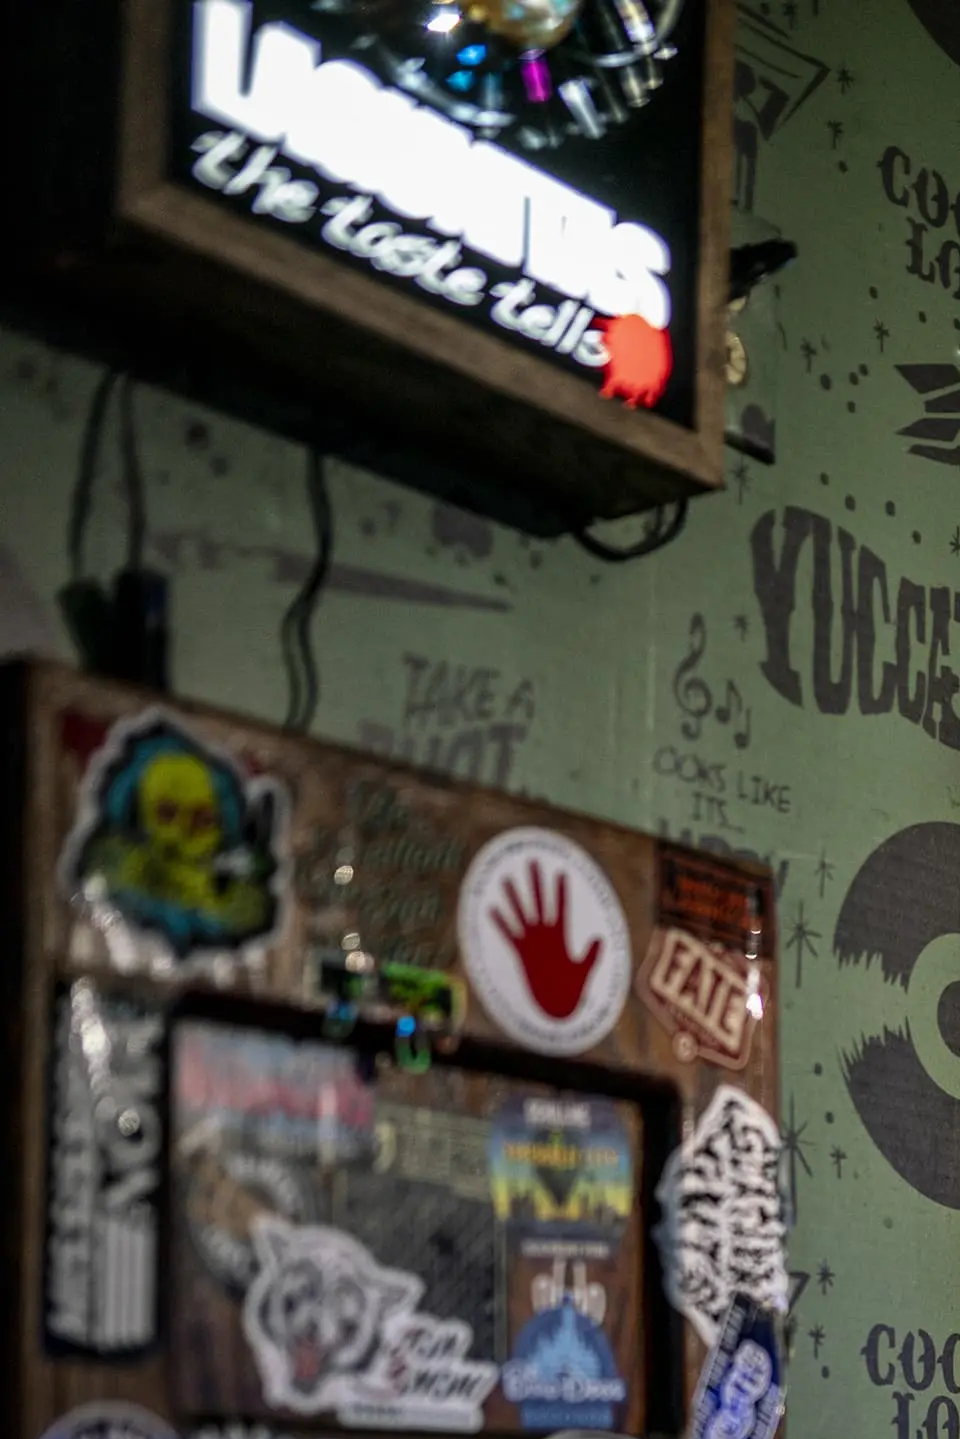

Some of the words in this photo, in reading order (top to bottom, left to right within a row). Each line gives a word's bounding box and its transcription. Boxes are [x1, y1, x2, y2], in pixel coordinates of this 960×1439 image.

[191, 131, 319, 223] the
[322, 193, 488, 306] taste
[490, 278, 611, 368] tells
[402, 650, 503, 726] TAKE
[507, 677, 537, 721] A
[652, 744, 727, 793] OOKS
[738, 770, 793, 814] LIKE
